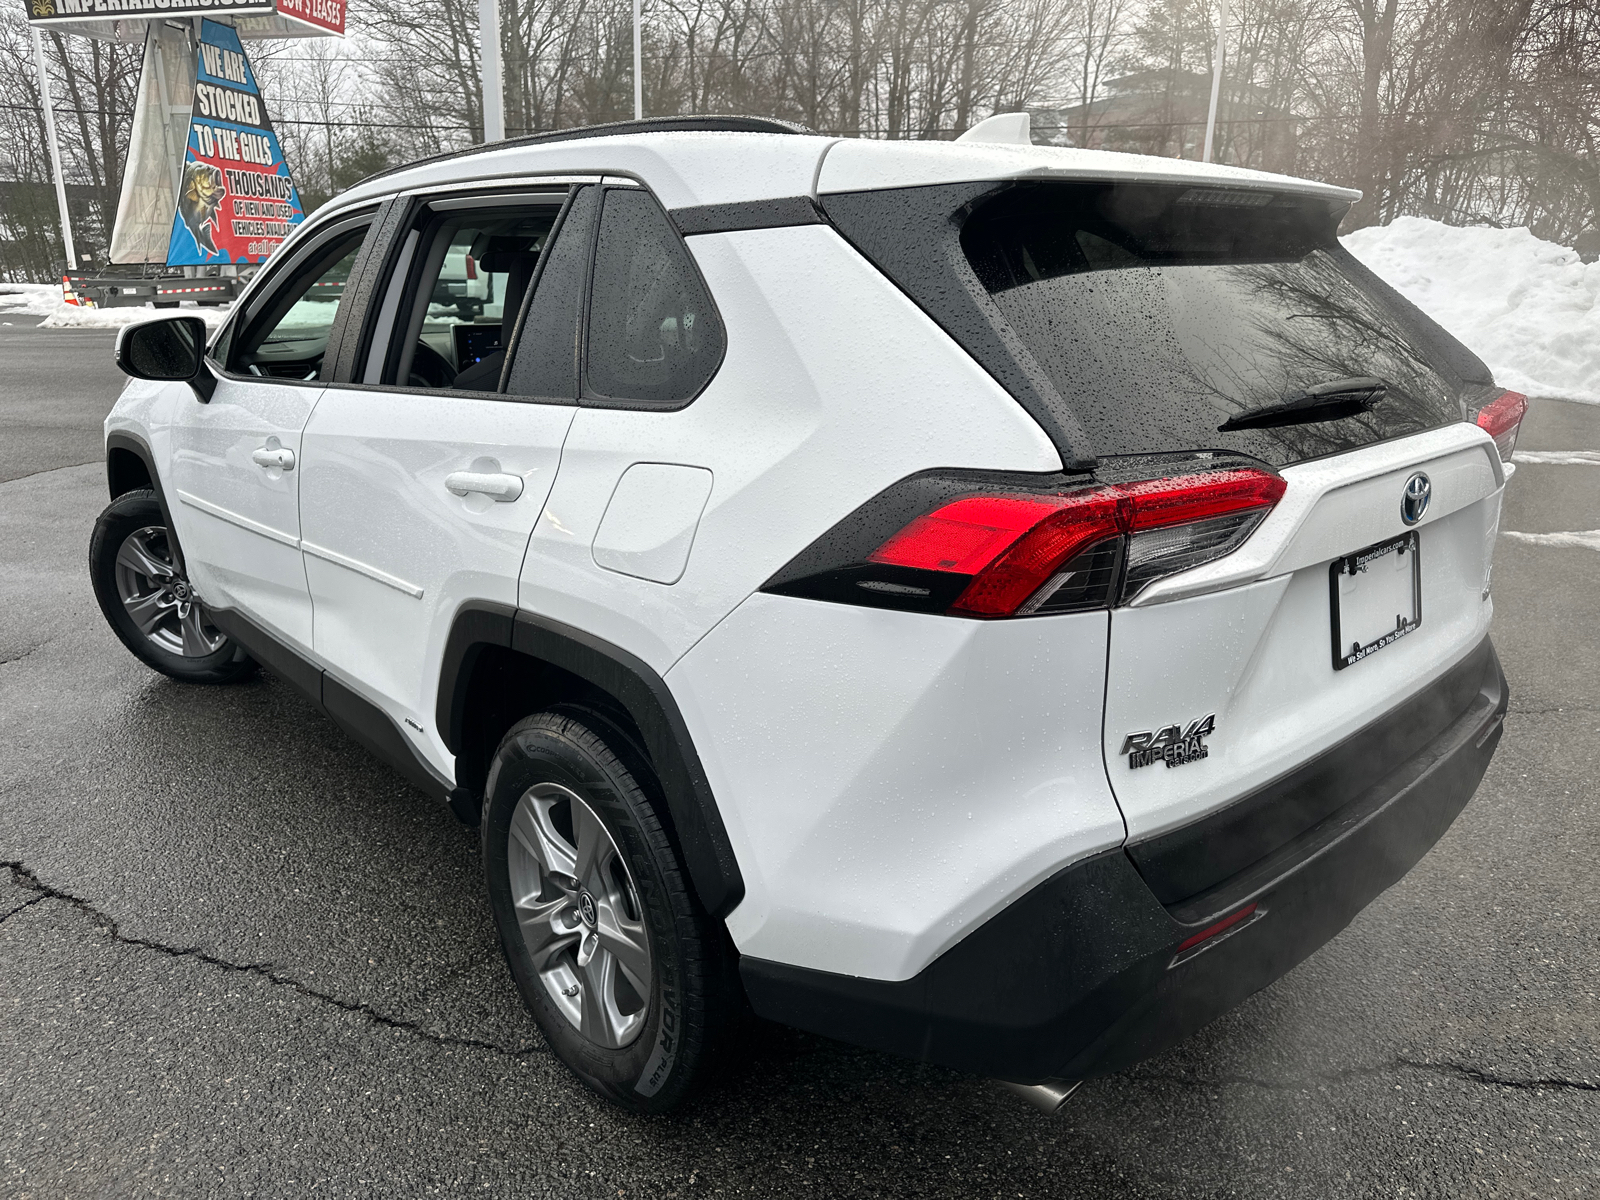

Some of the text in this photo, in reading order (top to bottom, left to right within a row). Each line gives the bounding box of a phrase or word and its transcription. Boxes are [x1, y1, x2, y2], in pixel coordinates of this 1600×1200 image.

[56, 0, 267, 14] IMPERIALC.
[312, 0, 341, 25] LEASES
[201, 42, 248, 85] WE ARE
[196, 83, 261, 126] STOCKED
[193, 124, 273, 166] TO THE GILLS
[225, 168, 293, 201] THOUSANDS
[233, 199, 293, 219] OF NEW AND USED
[231, 219, 299, 238] VEHICLES AVAILAB
[248, 241, 257, 254] at
[258, 239, 269, 254] all
[1356, 540, 1404, 566] Imperialcars.com
[1347, 655, 1356, 664] We
[1356, 648, 1366, 660] Sell
[1379, 639, 1386, 648] So
[1385, 634, 1395, 644] You
[1404, 623, 1416, 634] More
[1119, 712, 1216, 755] RAV4
[1129, 733, 1208, 769] IMPERIAL
[1166, 749, 1209, 768] cars.com
